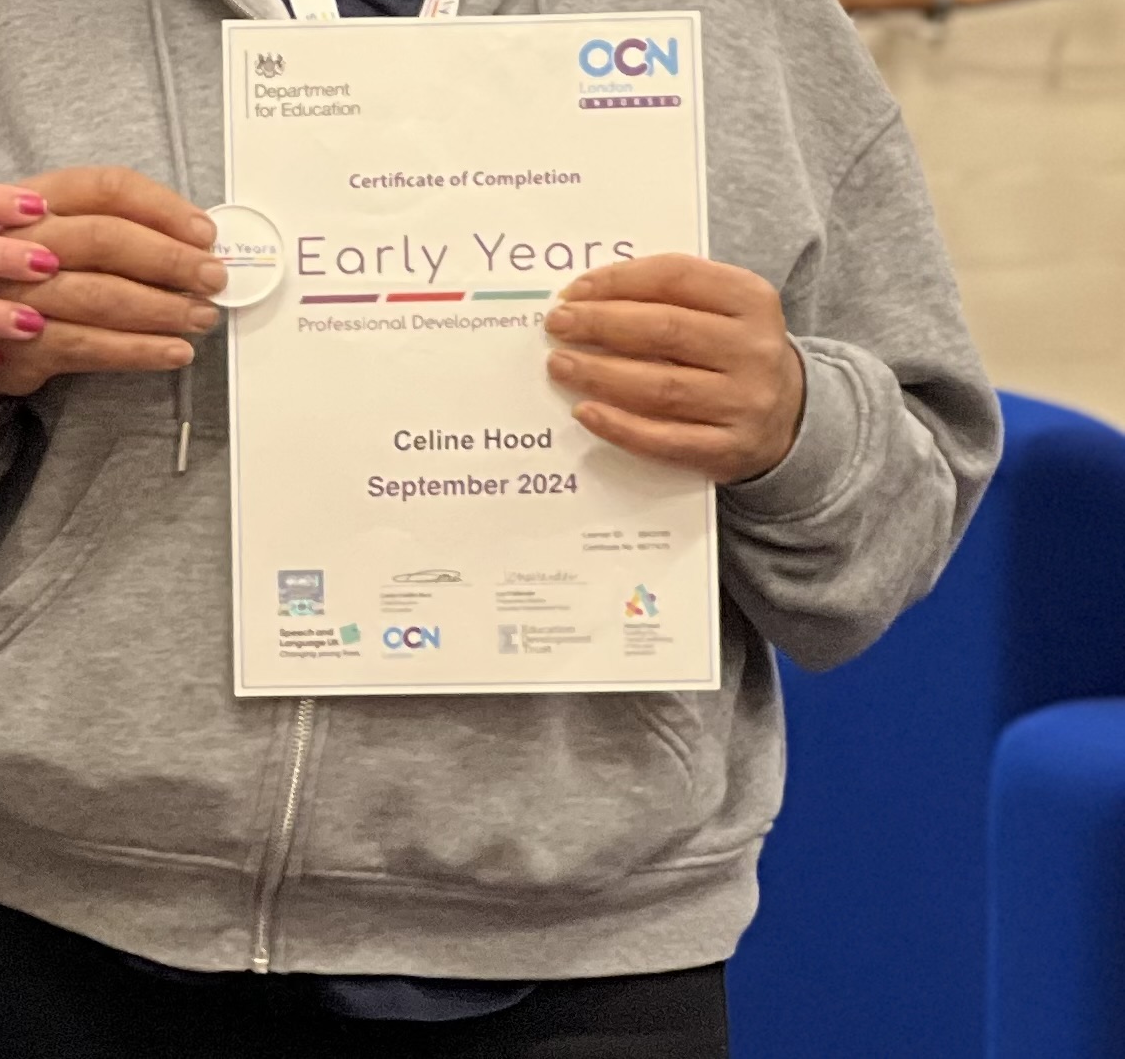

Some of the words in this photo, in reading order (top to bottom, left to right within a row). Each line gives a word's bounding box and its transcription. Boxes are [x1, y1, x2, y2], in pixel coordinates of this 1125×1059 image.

[579, 37, 679, 78] OCN
[254, 83, 350, 101] Department
[579, 81, 633, 94] London
[254, 103, 277, 118] for
[281, 101, 362, 118] Education
[349, 172, 445, 189] Certificate
[450, 170, 469, 187] of
[473, 168, 582, 190] Completion
[298, 234, 448, 284] Early
[473, 232, 635, 272] Years
[298, 315, 407, 333] Professional
[412, 313, 528, 332] Development
[393, 429, 475, 452] Celine
[484, 427, 552, 450] Hood
[367, 474, 510, 502] September
[517, 473, 578, 495] 2024
[382, 626, 440, 650] OCN
